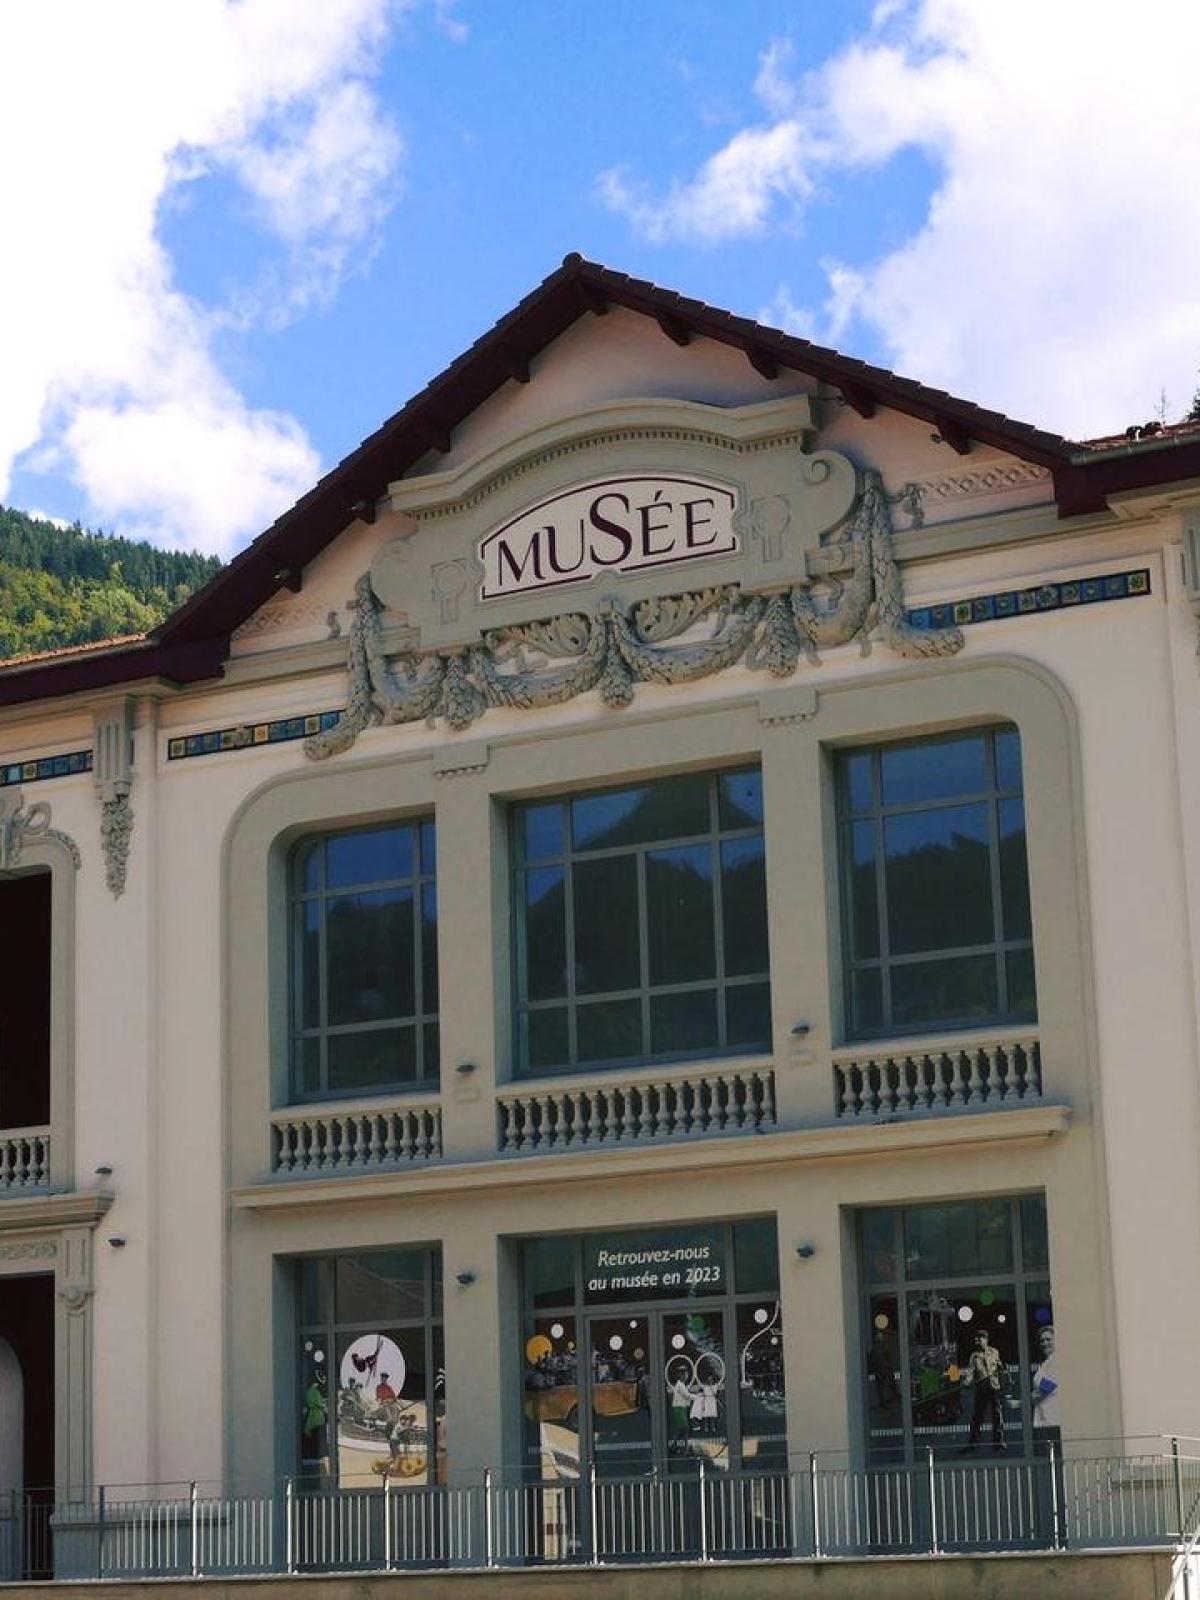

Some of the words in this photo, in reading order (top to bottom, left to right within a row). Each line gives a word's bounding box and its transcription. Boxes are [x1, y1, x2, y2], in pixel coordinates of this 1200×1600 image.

[498, 490, 718, 586] MUSÉE
[599, 1246, 710, 1267] Retrouvez-nous
[588, 1279, 607, 1291] au
[611, 1271, 658, 1288] musée
[662, 1273, 681, 1285] en
[685, 1266, 721, 1284] 2023
